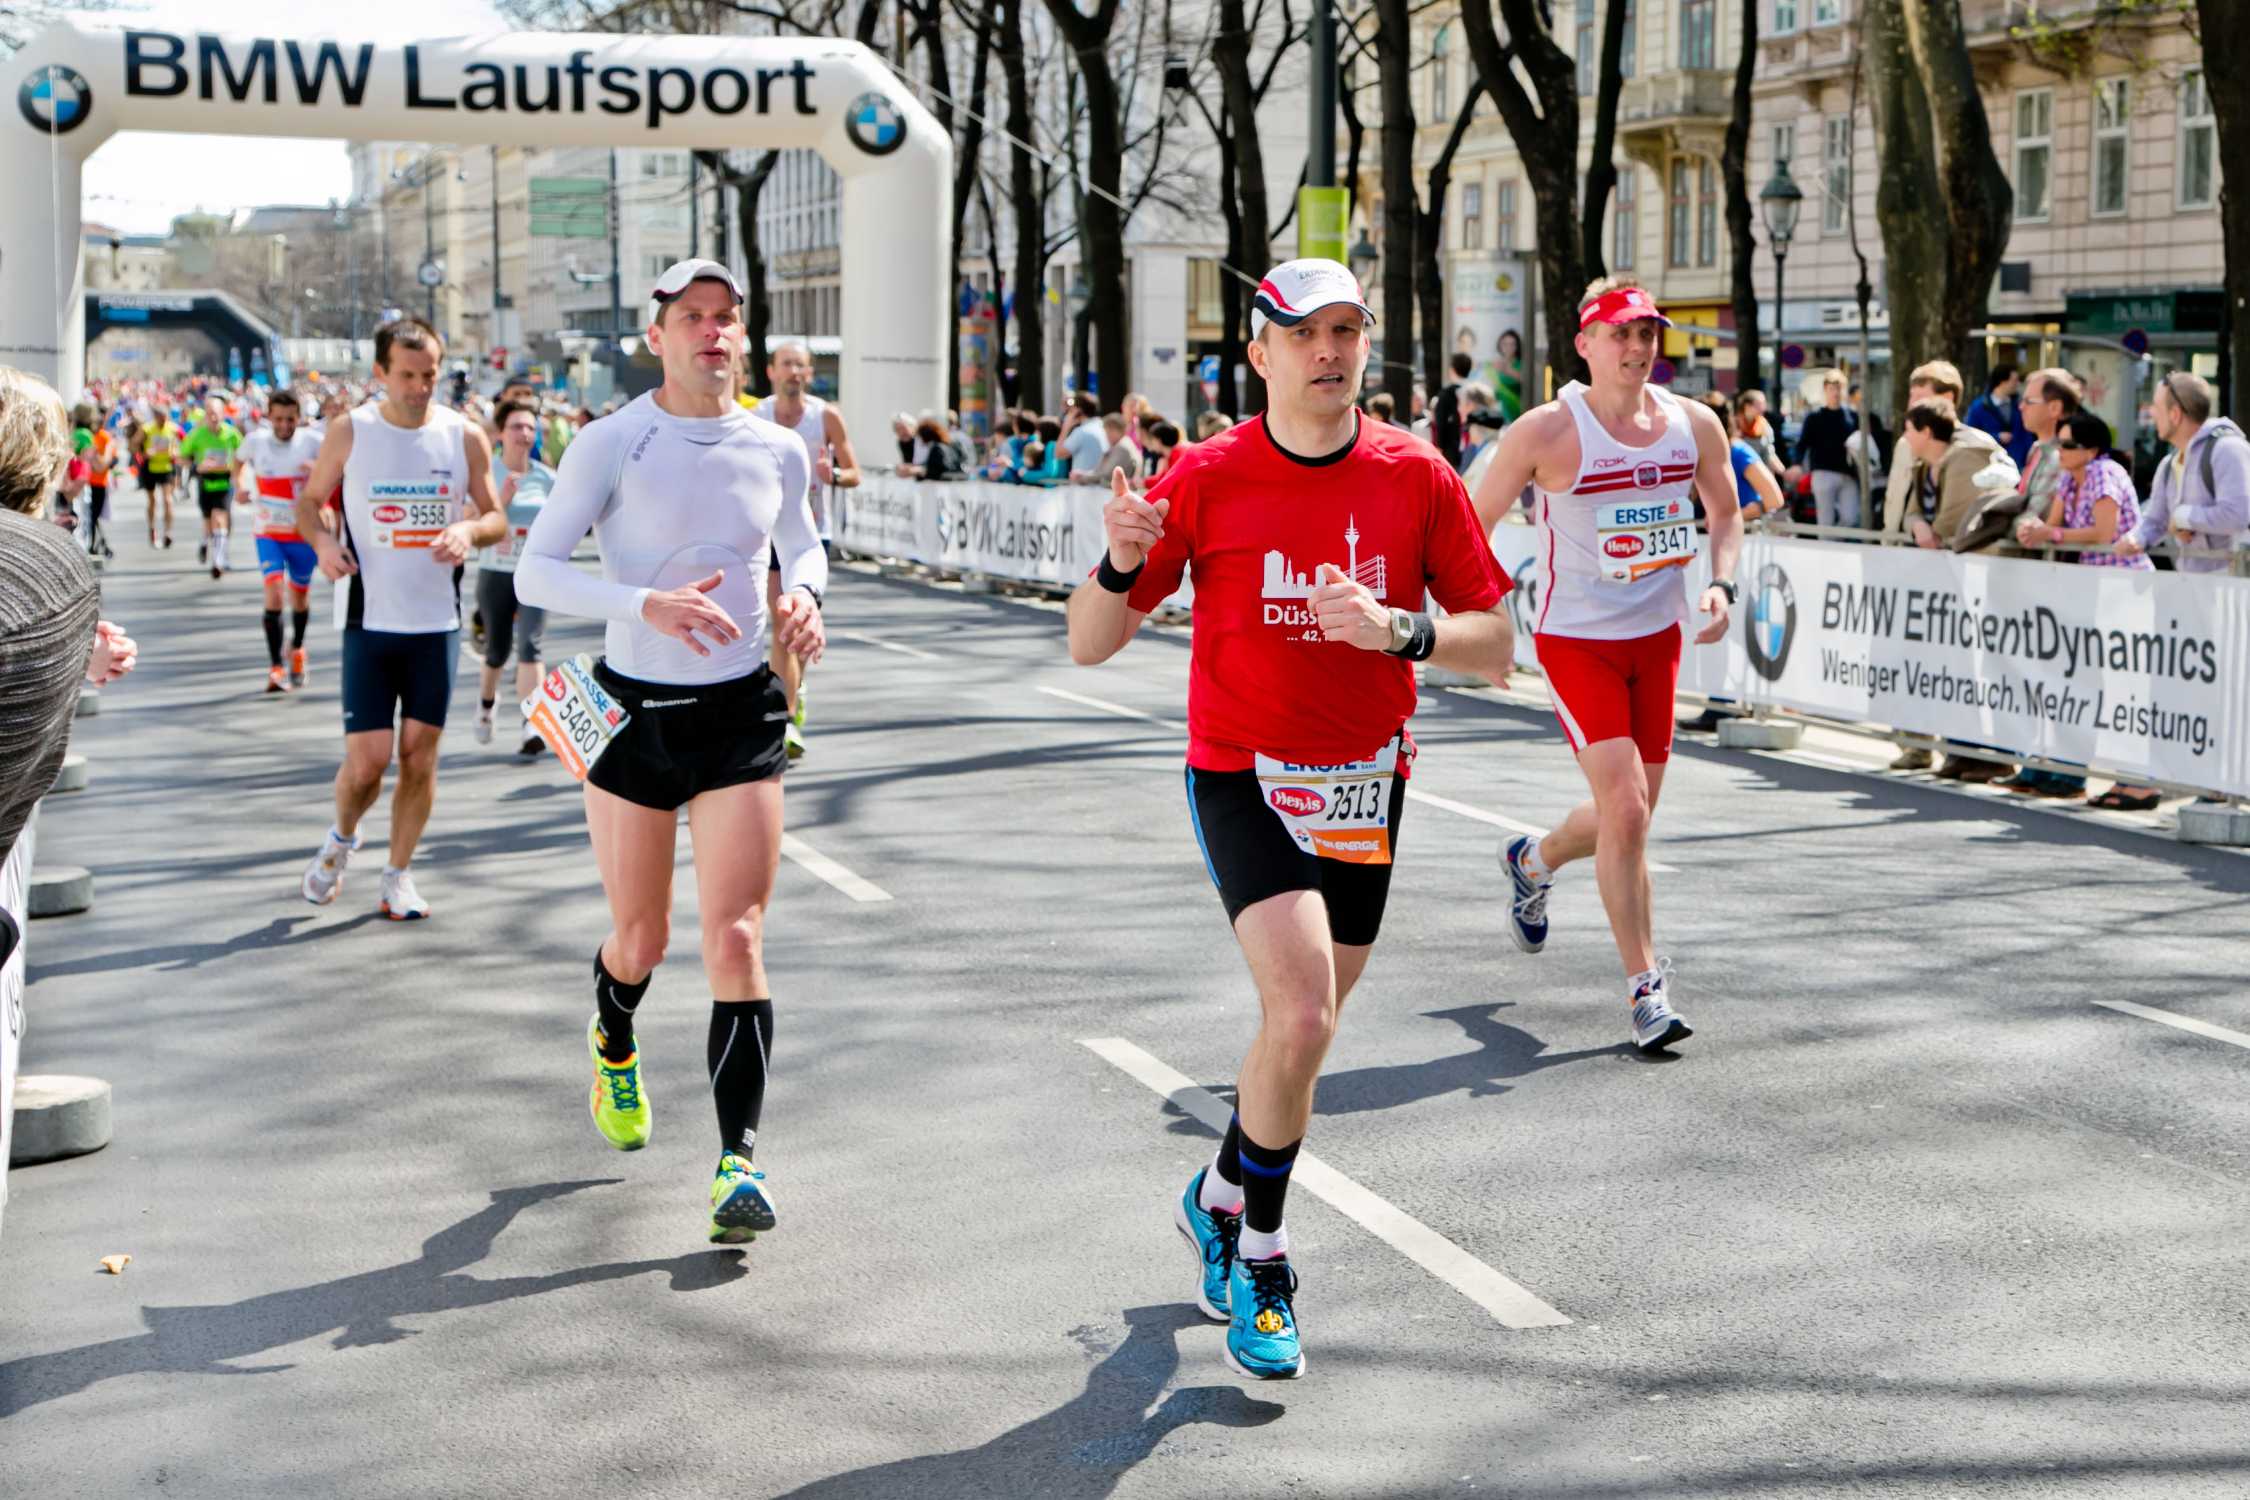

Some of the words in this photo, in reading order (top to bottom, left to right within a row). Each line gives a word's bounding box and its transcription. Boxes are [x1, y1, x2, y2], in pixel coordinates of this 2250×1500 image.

[125, 31, 373, 106] BMW
[404, 45, 818, 129] Laufsport
[410, 505, 446, 525] 9558
[1615, 506, 1666, 525] ERSTE
[1648, 526, 1688, 556] 3347
[1822, 581, 1898, 643] BMW
[1905, 589, 2217, 684] EfficientDynamics
[1822, 647, 1899, 699] Weniger
[1905, 660, 2020, 714] Verbrauch.
[2024, 678, 2090, 726] Mehr
[2093, 688, 2215, 756] Leistung.
[559, 696, 599, 754] 5480
[1274, 790, 1321, 812] Hervis
[1326, 781, 1381, 821] 3513
